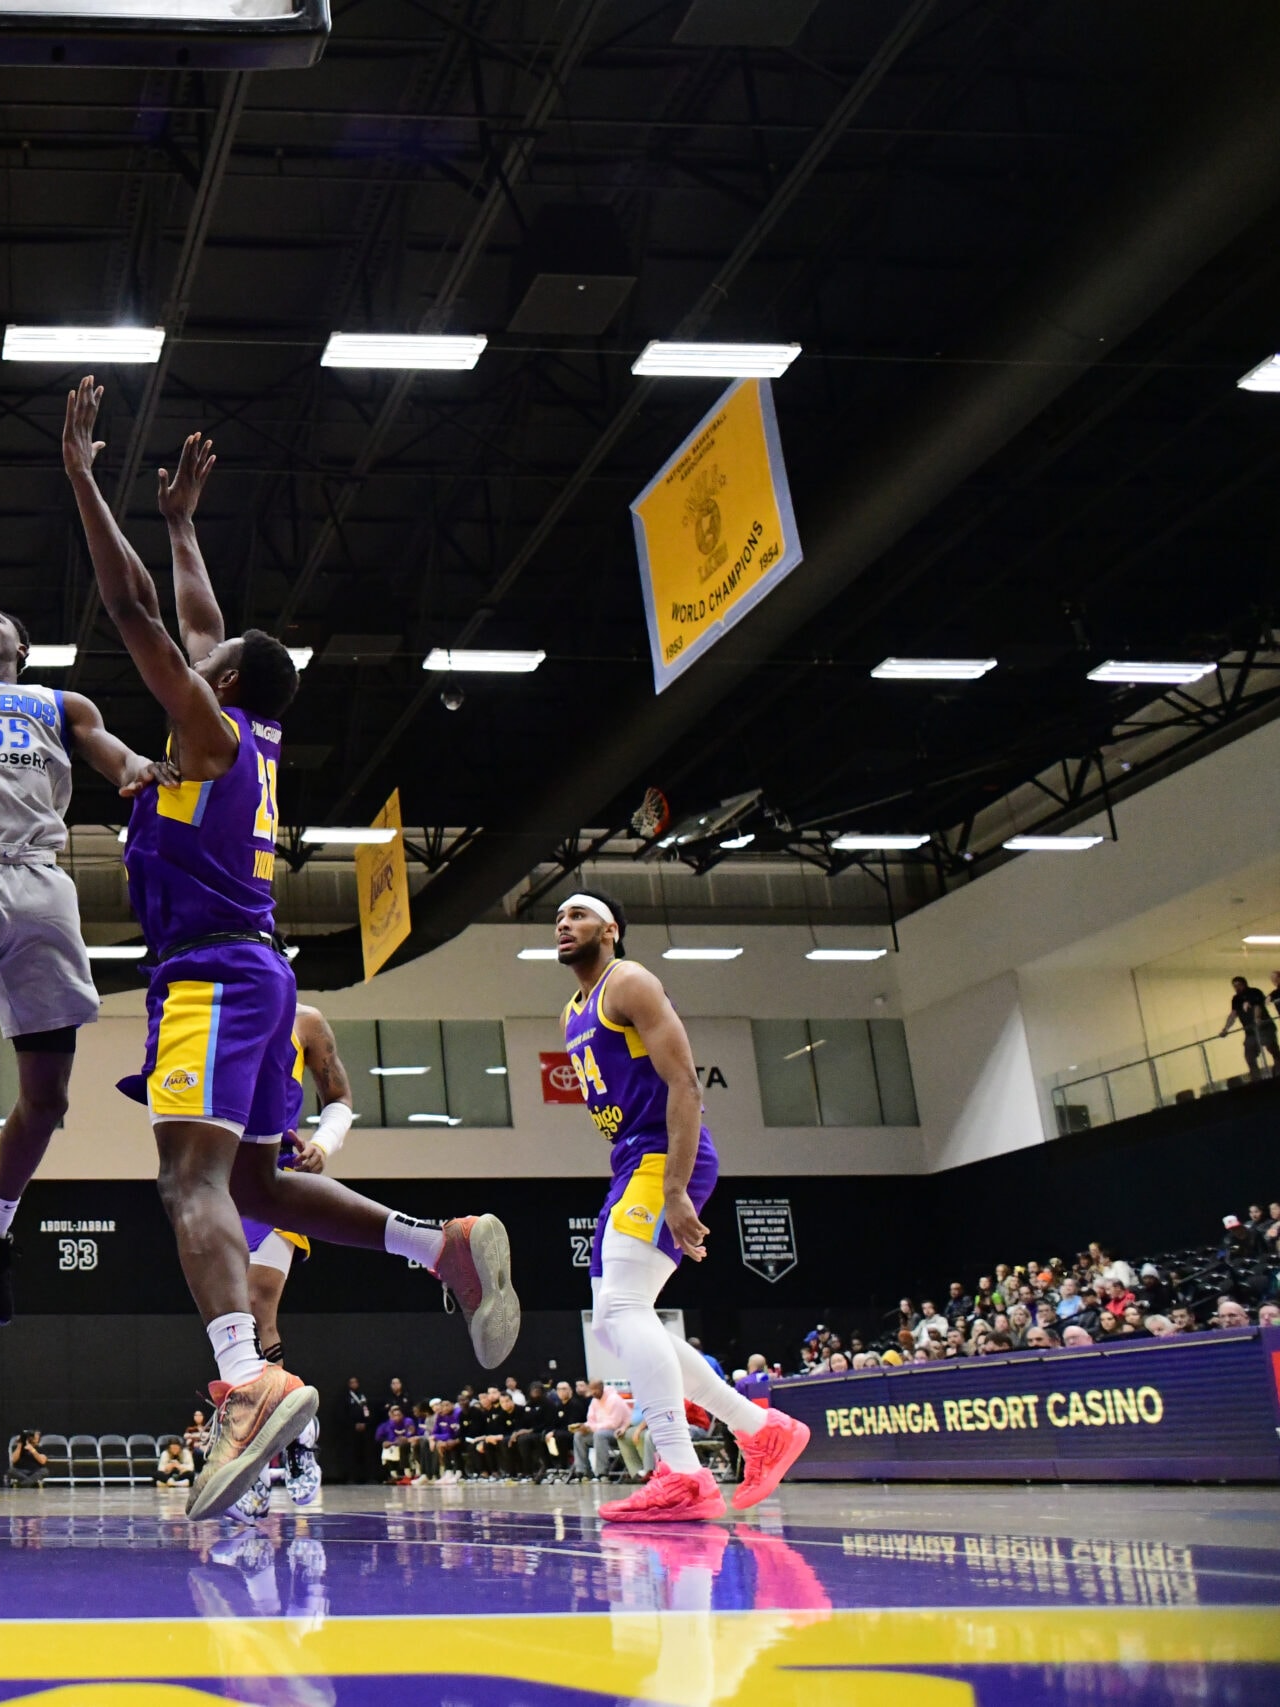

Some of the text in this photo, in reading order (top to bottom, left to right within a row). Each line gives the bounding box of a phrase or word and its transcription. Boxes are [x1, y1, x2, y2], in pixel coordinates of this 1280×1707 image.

[671, 600, 706, 623] WORLD
[708, 520, 764, 612] CHAMPIONS
[40, 1220, 116, 1232] ABDUL-JABBAR
[568, 1217, 599, 1230] BAYLO
[58, 1239, 98, 1270] 33
[570, 1236, 595, 1267] 2
[825, 1385, 1164, 1438] PECHANGA RESORT CASINO
